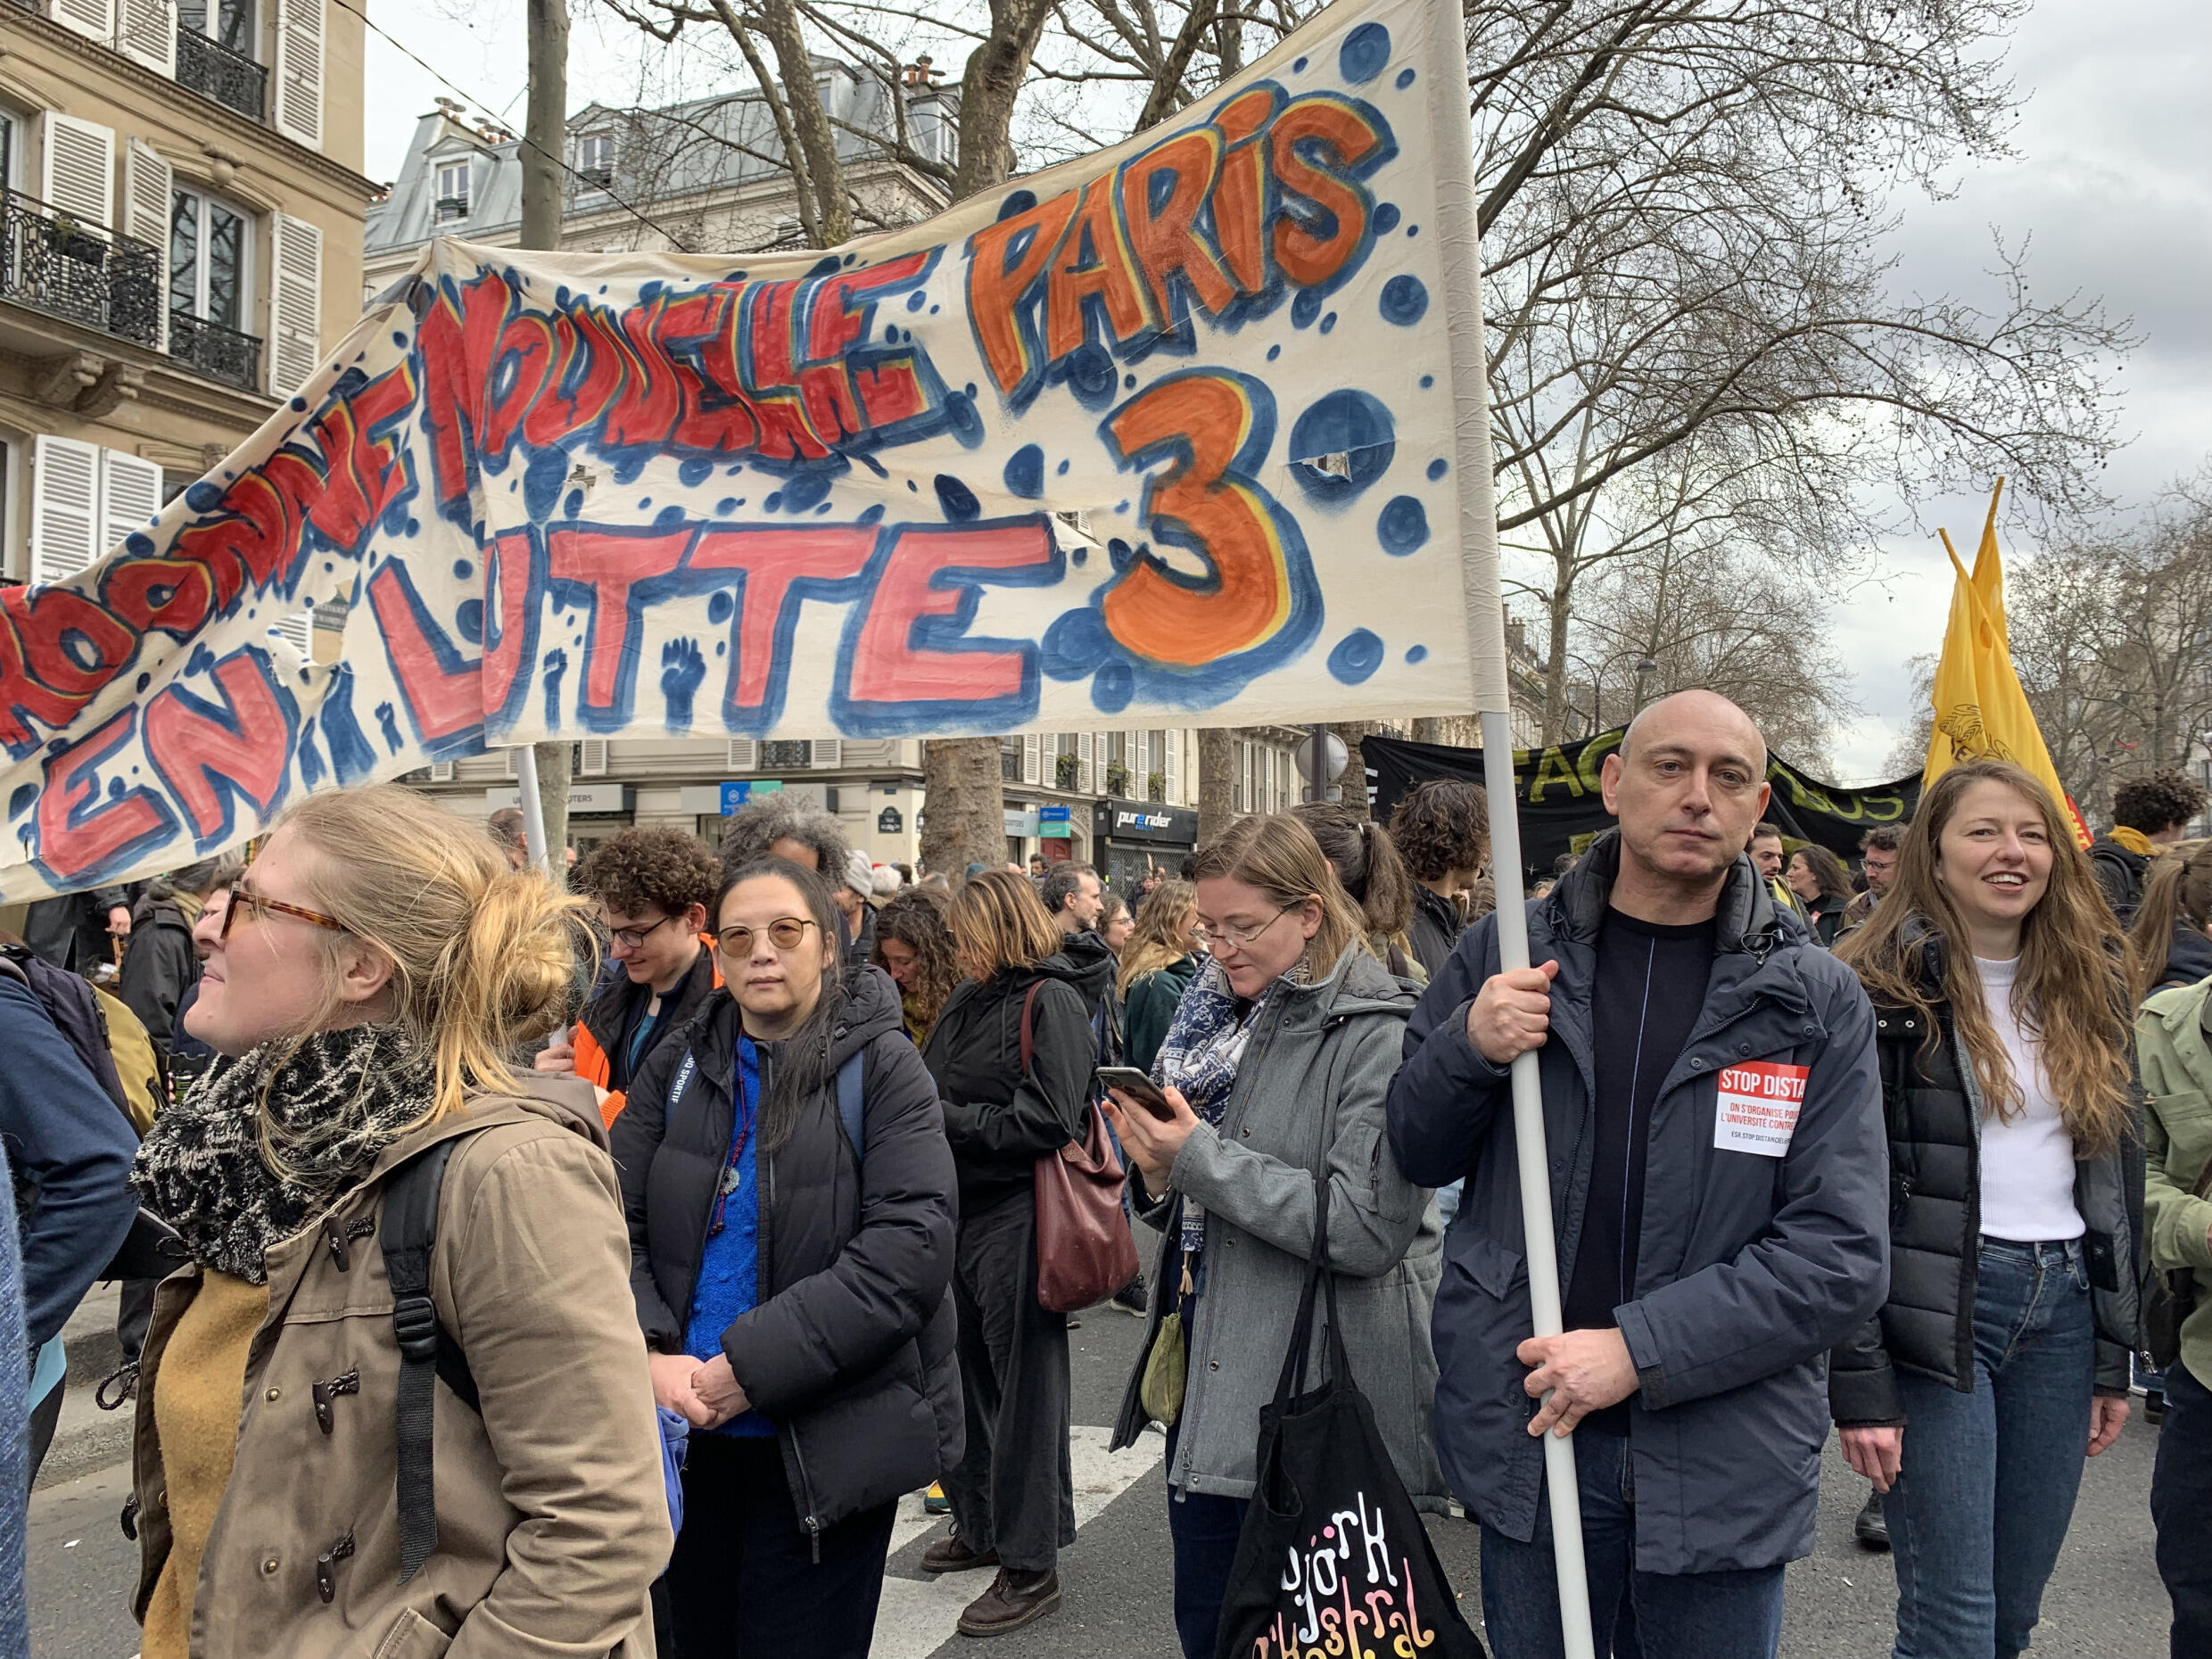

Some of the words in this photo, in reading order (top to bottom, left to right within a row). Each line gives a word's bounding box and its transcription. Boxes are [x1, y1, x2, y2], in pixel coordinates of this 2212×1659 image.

[1098, 366, 1325, 696] 3
[33, 644, 297, 890] EN
[367, 510, 1067, 763] LUTTE
[671, 1069, 691, 1104] SPORTIF
[1721, 1069, 1762, 1094] STOP
[1762, 1074, 1807, 1099] DISTA
[1721, 1111, 1768, 1128] L'UNIVERSITÉ
[1769, 1119, 1795, 1132] CONTRE
[1729, 1102, 1740, 1112] ON
[1741, 1103, 1783, 1118] S'ORGANISE
